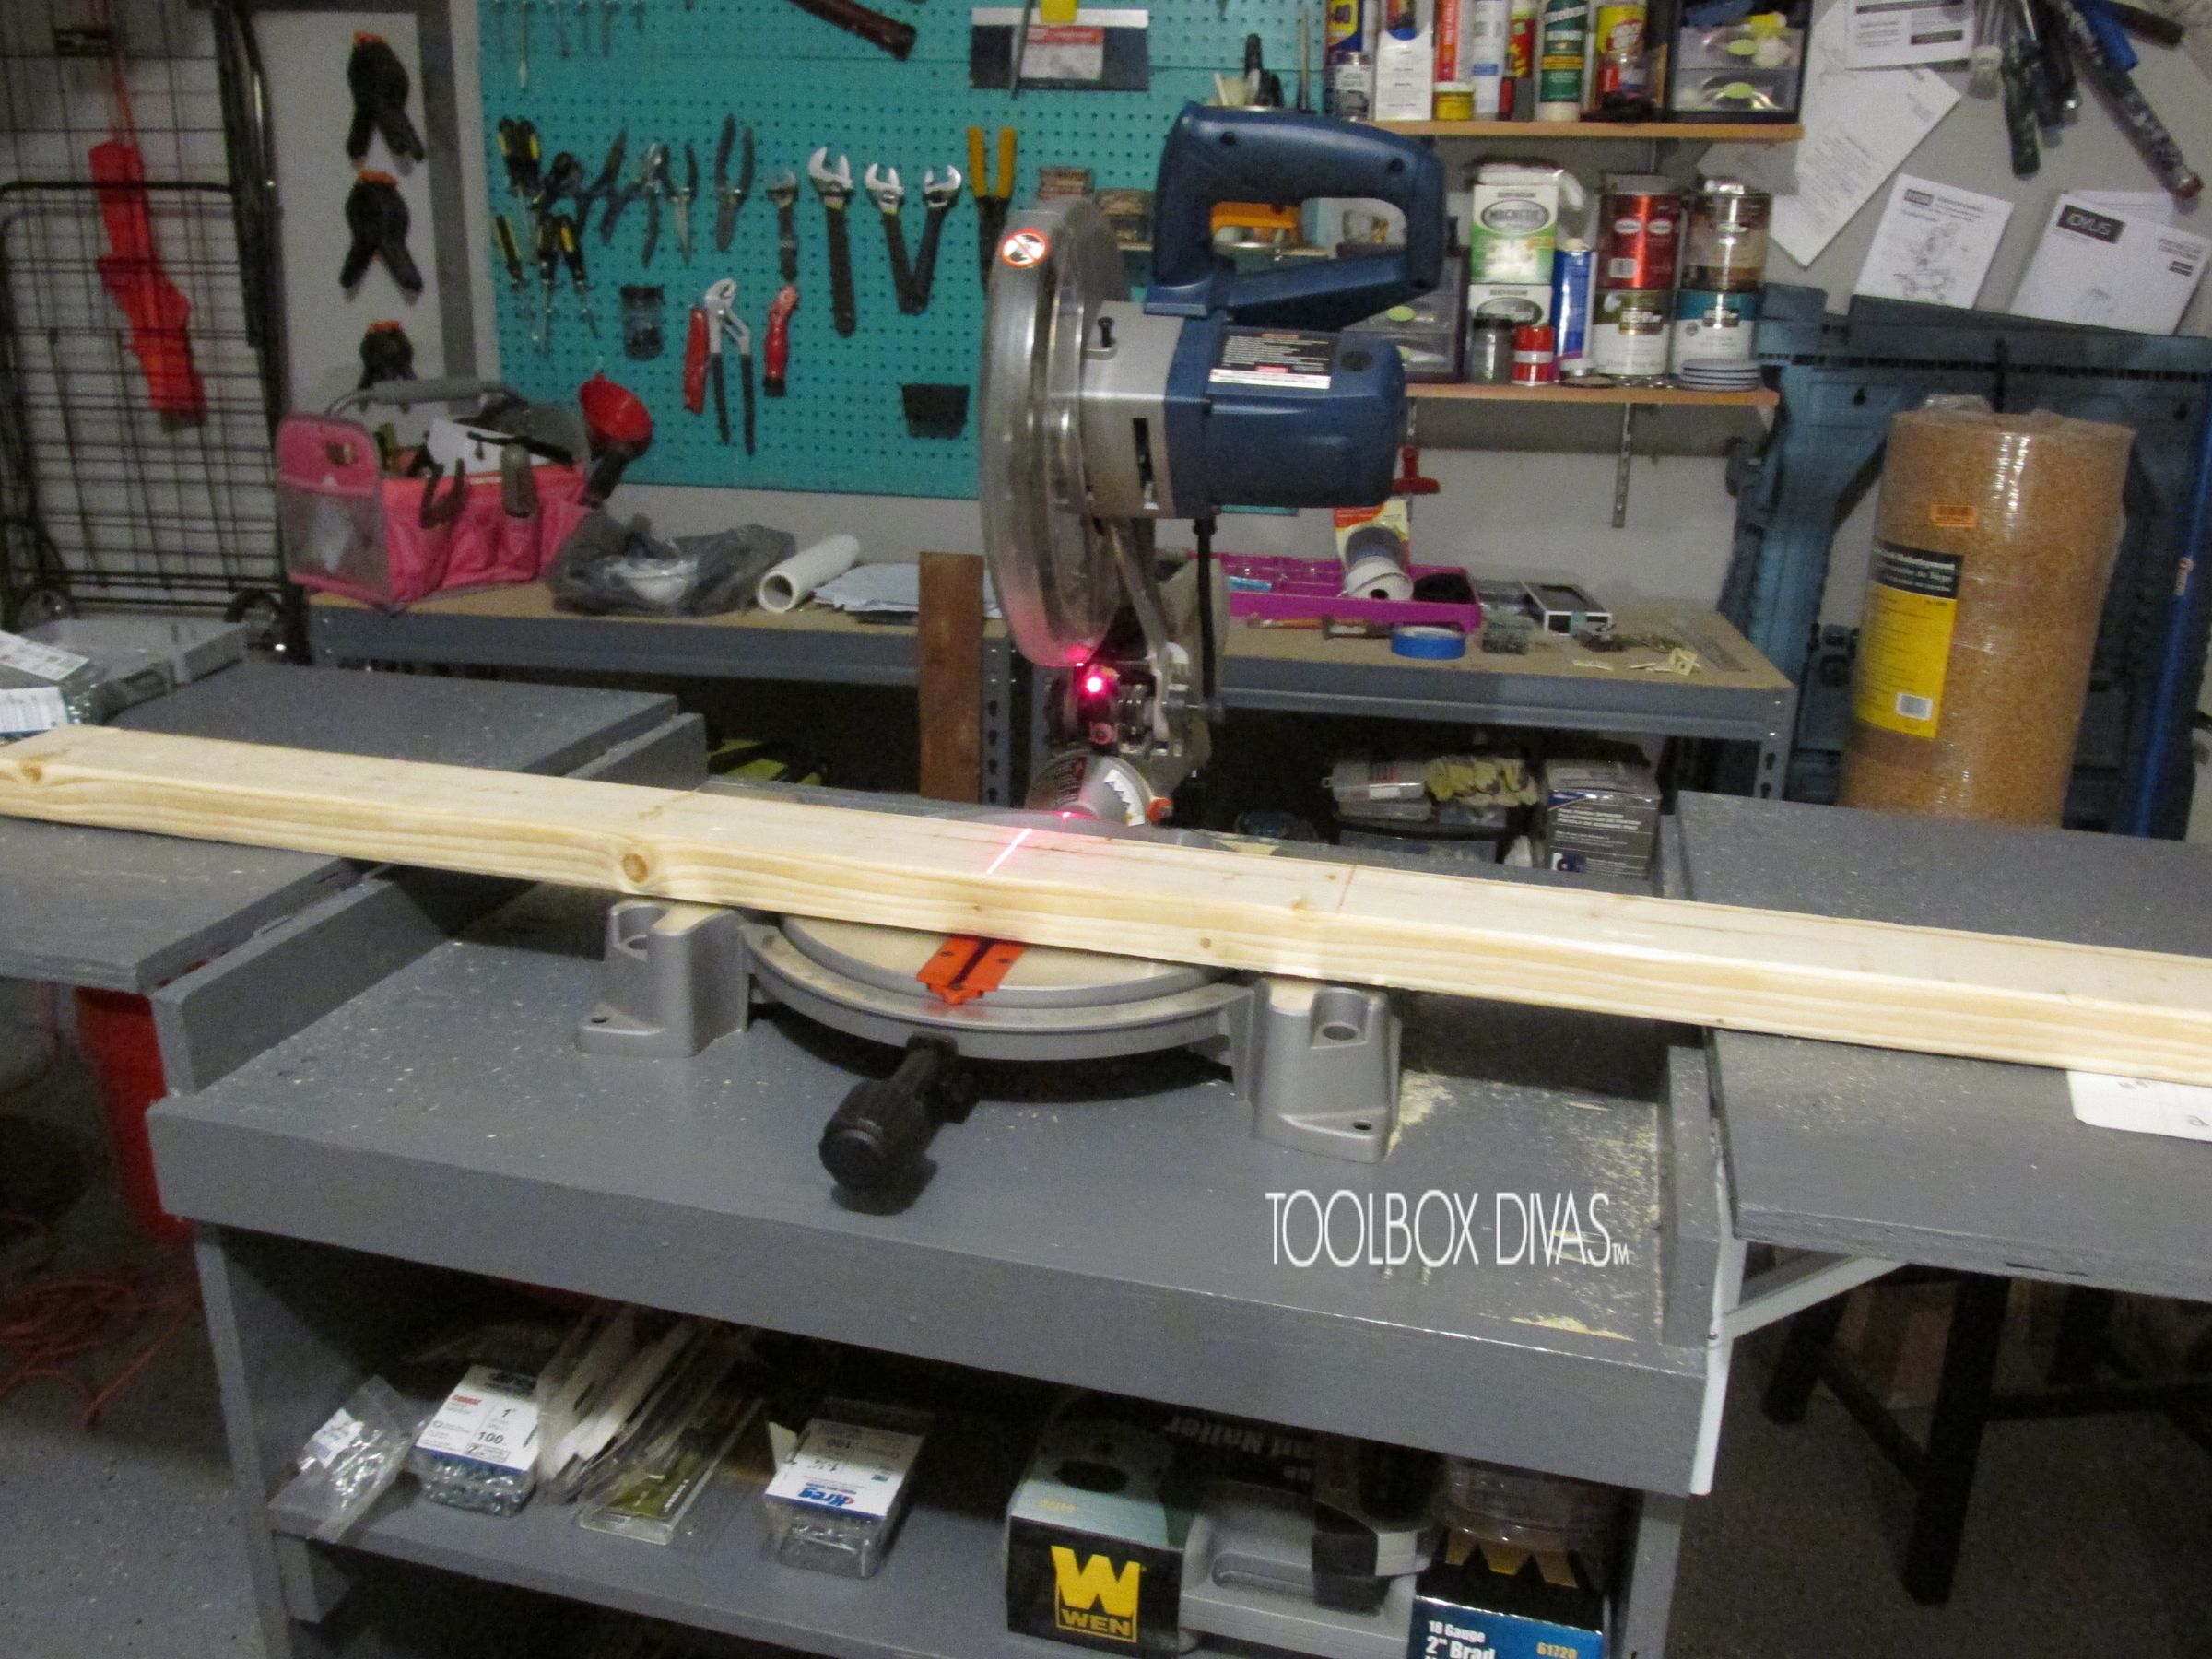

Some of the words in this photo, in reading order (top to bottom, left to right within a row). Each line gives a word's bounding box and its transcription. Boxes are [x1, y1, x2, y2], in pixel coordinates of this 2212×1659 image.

[478, 1430, 504, 1445] 100
[798, 1487, 848, 1507] Kreg
[1061, 1609, 1131, 1637] WEN
[1429, 1619, 1442, 1634] 18
[1444, 1623, 1486, 1643] Gauge
[1425, 1634, 1448, 1655] 2"
[1448, 1641, 1497, 1659] Brad
